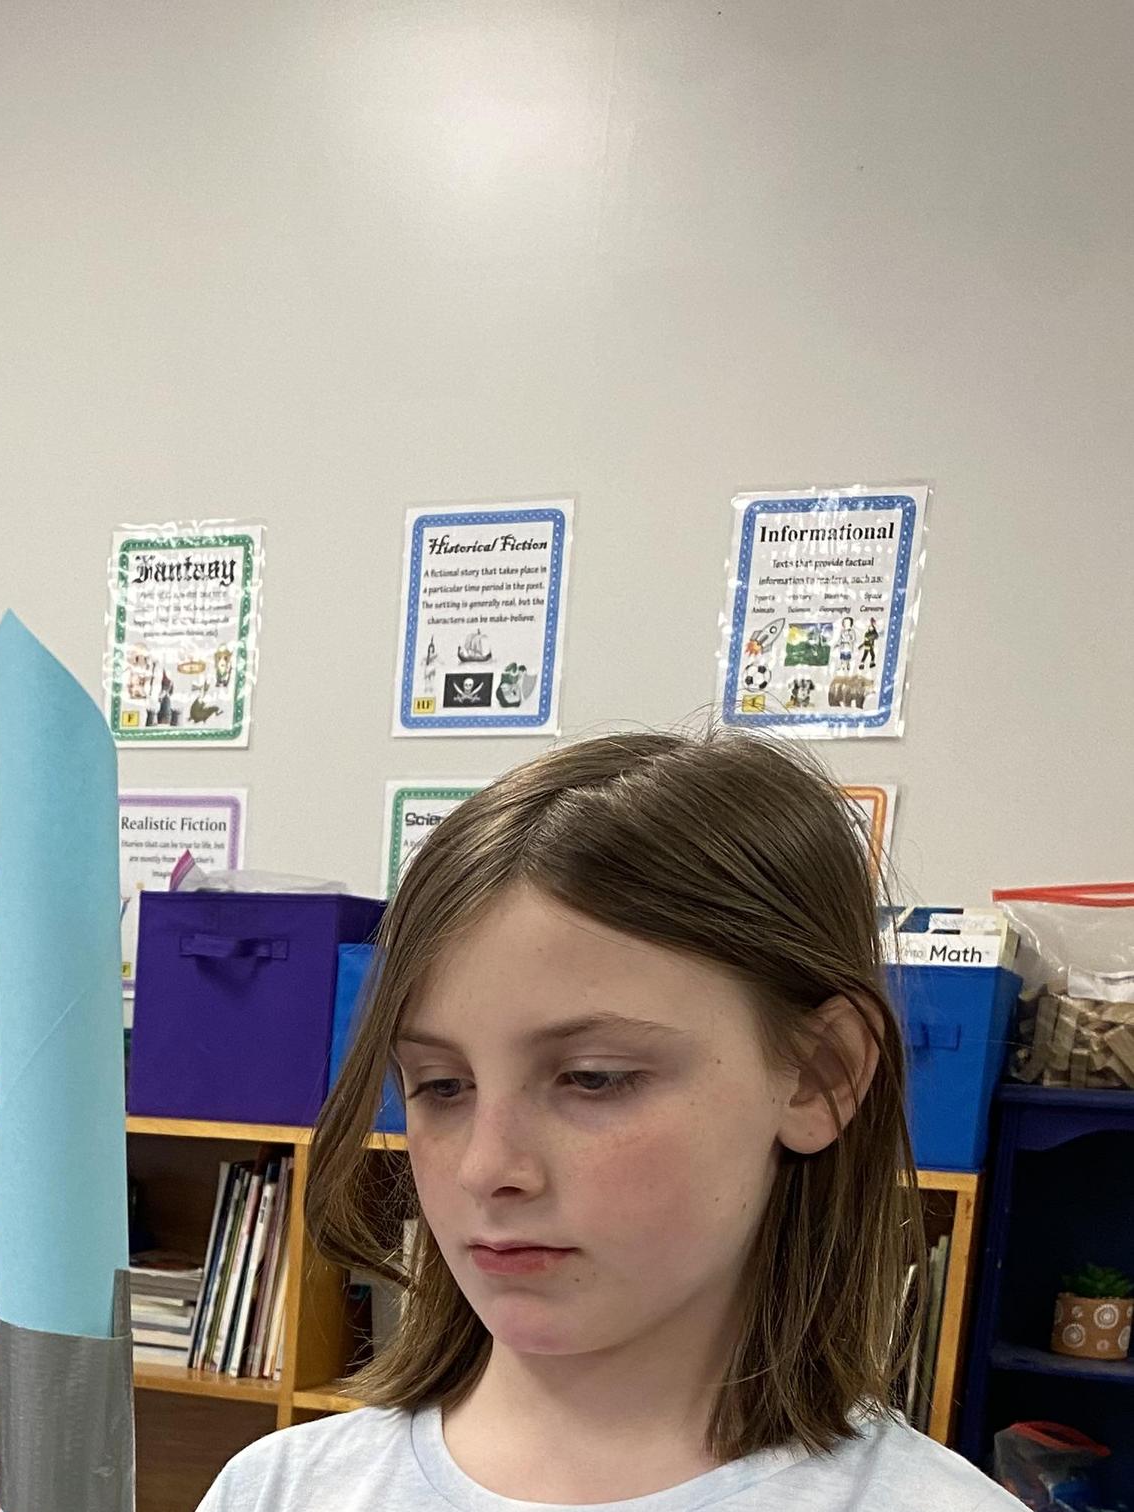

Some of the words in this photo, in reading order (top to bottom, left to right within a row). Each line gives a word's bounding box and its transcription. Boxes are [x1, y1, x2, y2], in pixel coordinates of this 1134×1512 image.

[760, 522, 895, 543] Informational
[428, 533, 499, 555] Historical
[500, 533, 548, 552] Fiction
[131, 554, 237, 588] Fantasy
[430, 568, 460, 577] fictional
[460, 568, 479, 577] story
[481, 567, 497, 575] that
[499, 566, 519, 575] takes
[519, 565, 539, 576] place
[814, 558, 844, 571] provide
[845, 556, 875, 567] factual
[758, 576, 805, 586] information
[428, 584, 463, 596] particular
[464, 584, 480, 593] time
[481, 582, 504, 594] period
[513, 582, 525, 590] the
[434, 601, 460, 610] setting
[469, 598, 500, 610] generally
[519, 598, 531, 606] but
[532, 597, 545, 605] the
[427, 615, 466, 625] characters
[121, 816, 177, 831] Realistic
[180, 816, 227, 832] Fiction
[929, 944, 982, 963] Math
